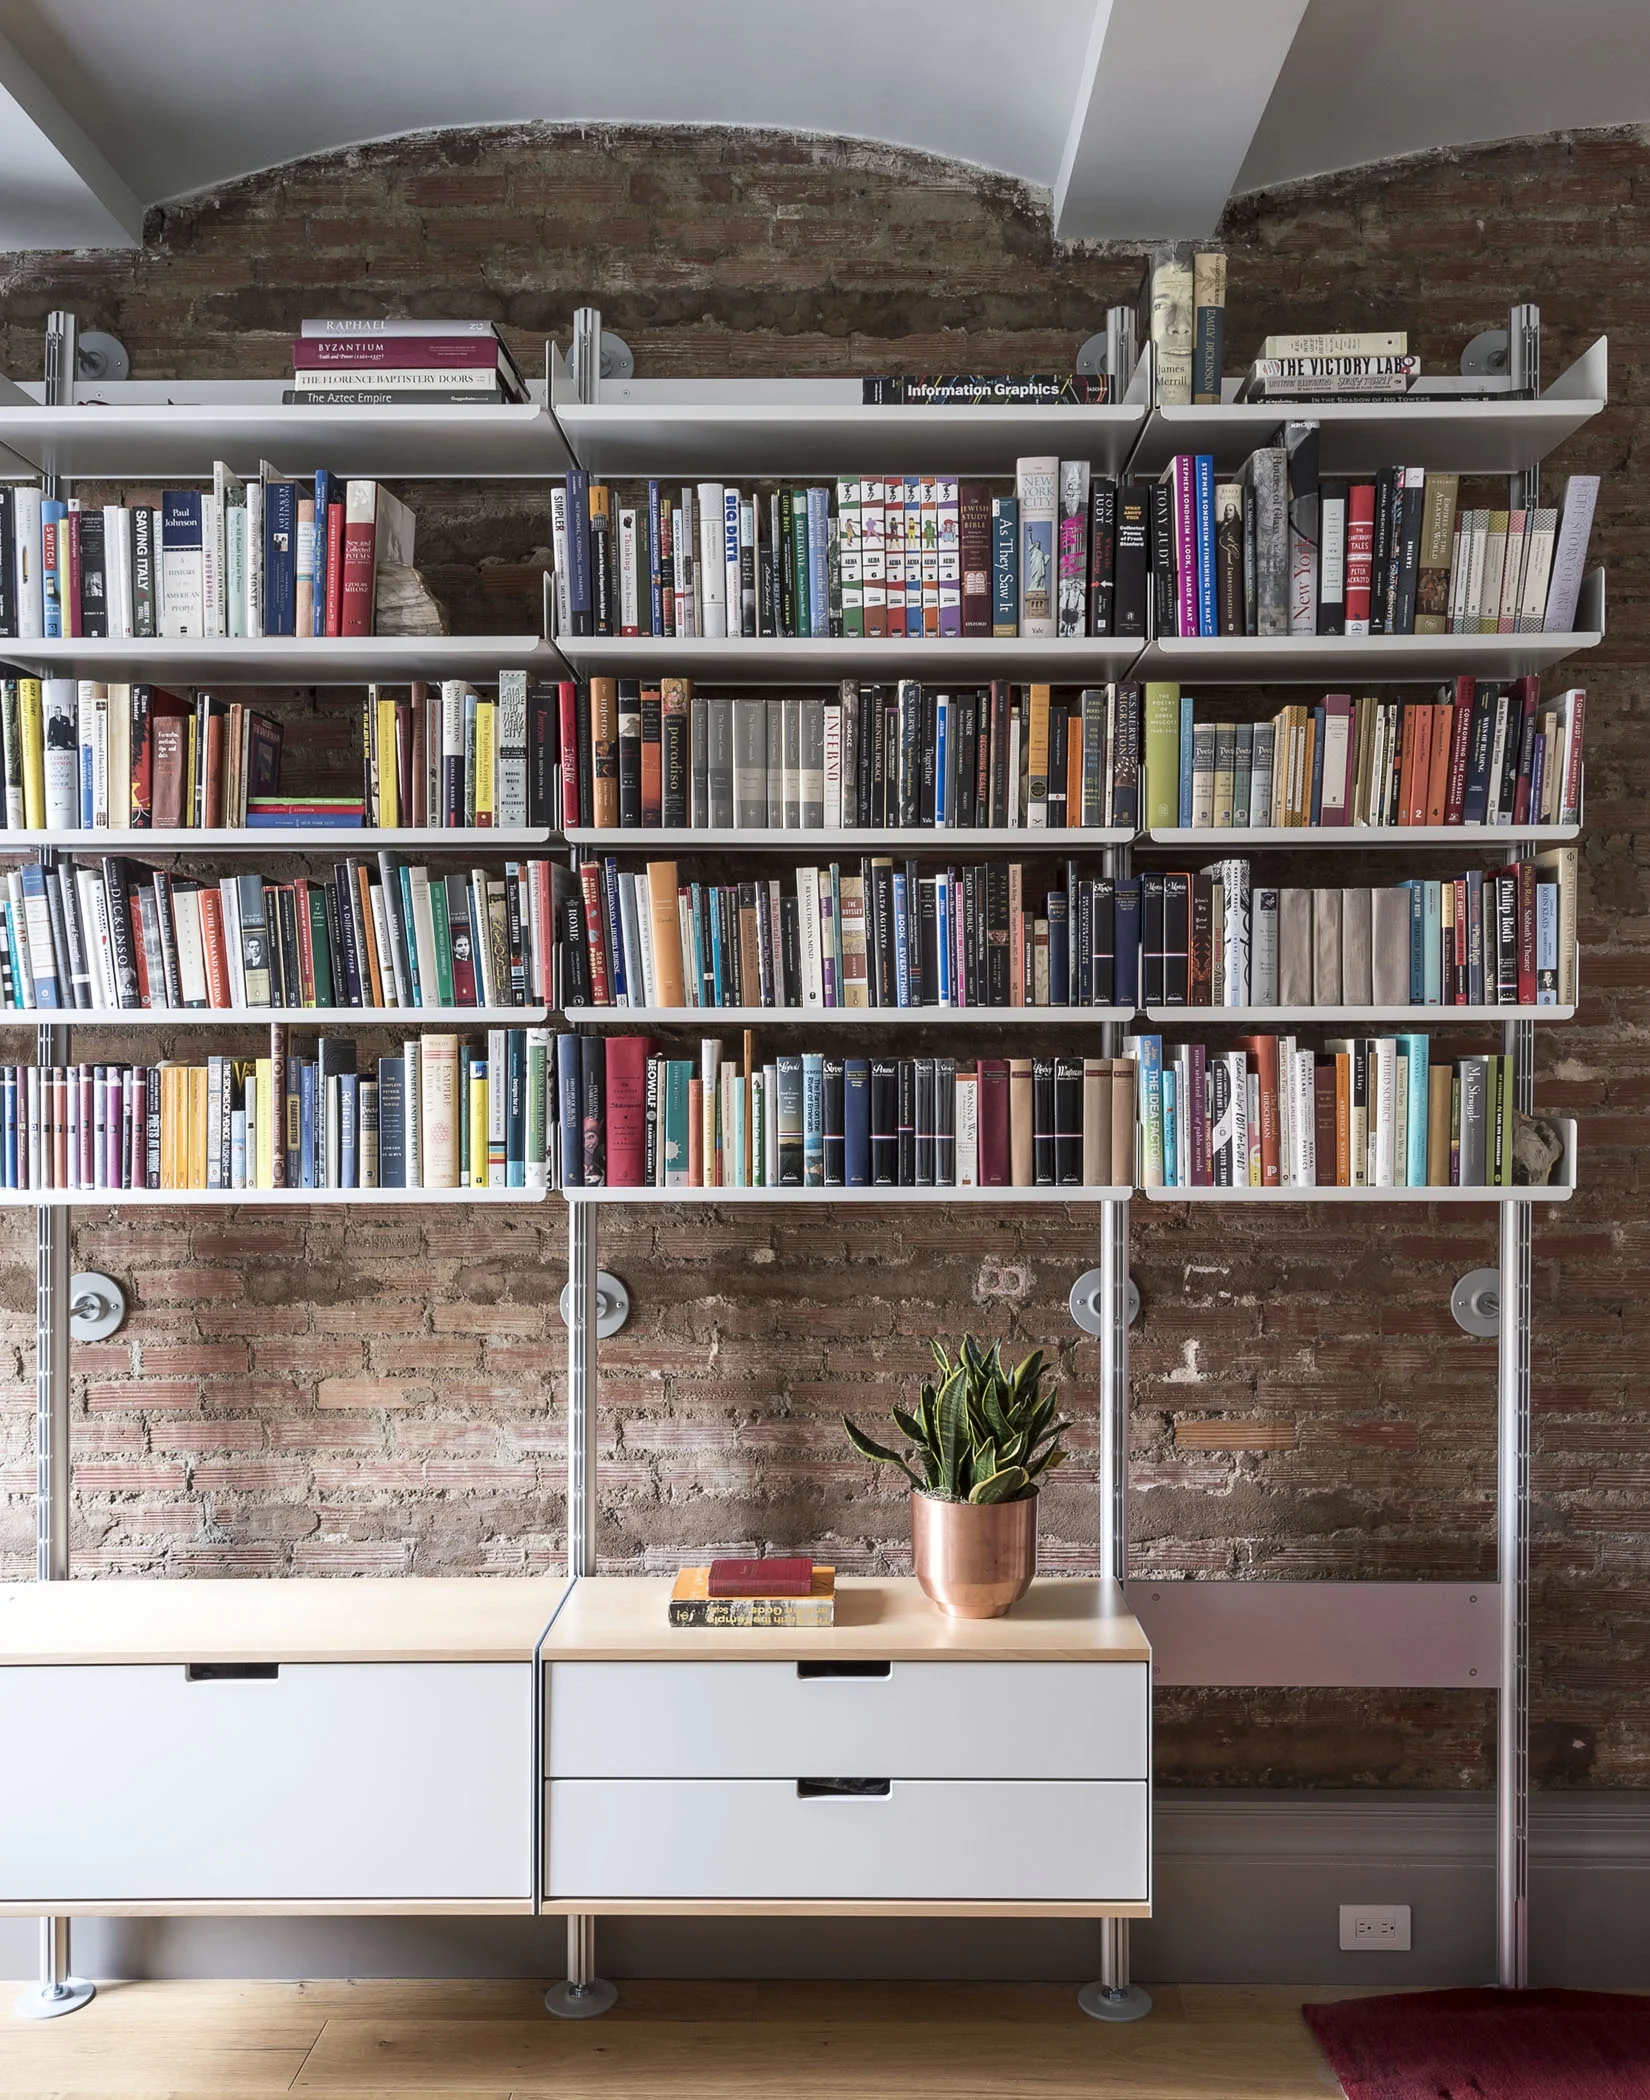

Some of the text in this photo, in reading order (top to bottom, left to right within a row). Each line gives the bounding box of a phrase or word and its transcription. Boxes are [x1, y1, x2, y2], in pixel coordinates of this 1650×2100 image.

[326, 320, 387, 330] RAPHAEL
[318, 344, 384, 352] BYZANTIUM
[1204, 309, 1216, 391] EMILY DICKINSON
[301, 374, 474, 384] THE FLORENCE BAPTISTERY DOORS
[1156, 376, 1187, 386] Merrill
[1158, 365, 1185, 374] James
[1280, 357, 1402, 376] THE VICTORY LAB
[308, 393, 392, 404] The Aztec Empire
[908, 384, 1059, 398] Information Graphics
[1022, 486, 1056, 496] YORK
[1024, 477, 1052, 486] NEW
[1183, 458, 1191, 492] STEPHEN
[1024, 498, 1052, 507] CITY
[1096, 493, 1104, 523] JUDT
[1105, 492, 1113, 524] TONY
[1272, 456, 1282, 534] Houses of Glass
[165, 518, 198, 527] Johnson
[173, 508, 190, 517] Paul
[554, 496, 565, 532] SIMPLER
[726, 496, 738, 562] BIG DATA
[782, 516, 790, 532] Bets
[1156, 488, 1169, 567] TONY JUDT
[1184, 494, 1192, 534] SONDHEIM
[1202, 499, 1210, 541] SONDHEIM
[1378, 484, 1388, 557] ANIMAL ARCHITECTURE
[46, 527, 55, 564] SWITCH
[136, 510, 148, 590] SAVING ITALY
[624, 534, 632, 570] Thinking
[796, 520, 804, 568] RECITATIVE
[1184, 544, 1192, 568] LOOK,
[1406, 541, 1414, 568] TARTINE
[994, 518, 1013, 612] As They Saw It
[1293, 538, 1311, 620] New York
[1186, 606, 1194, 622] HAT
[538, 710, 548, 743] Emerson
[600, 698, 608, 738] inferno
[1128, 692, 1136, 754] W.S. MERWIN
[1460, 708, 1470, 757] CONFRONTING
[1574, 720, 1582, 740] JUDT
[668, 727, 682, 790] paradiso
[827, 716, 838, 781] INFERNO
[482, 764, 490, 802] Everything
[538, 777, 544, 786] ON
[924, 746, 934, 786] Together
[1456, 774, 1464, 804] CLASSICS
[206, 899, 213, 910] TO
[966, 900, 974, 934] REPUBLIC
[1498, 880, 1514, 943] Philip Roth
[1522, 865, 1532, 972] Philip Roth Sabbath's Theater
[111, 888, 128, 976] DICKINSON
[344, 914, 353, 946] Different
[568, 909, 580, 942] ROME
[806, 930, 814, 938] IN
[208, 930, 218, 966] FINLAND
[347, 950, 355, 974] Person
[212, 968, 222, 1002] STATION
[410, 1051, 418, 1066] THE
[1356, 1056, 1364, 1090] phil klay
[410, 1070, 418, 1100] UNREAL
[648, 1059, 656, 1108] BEOWULF
[1382, 1054, 1391, 1123] THIRD SOURCE
[1466, 1066, 1480, 1122] My Struggle
[967, 1083, 976, 1141] SWANN'S WAY
[1149, 1068, 1160, 1170] THE IDEA FACTORY
[149, 1114, 160, 1172] POETS AT WORK
